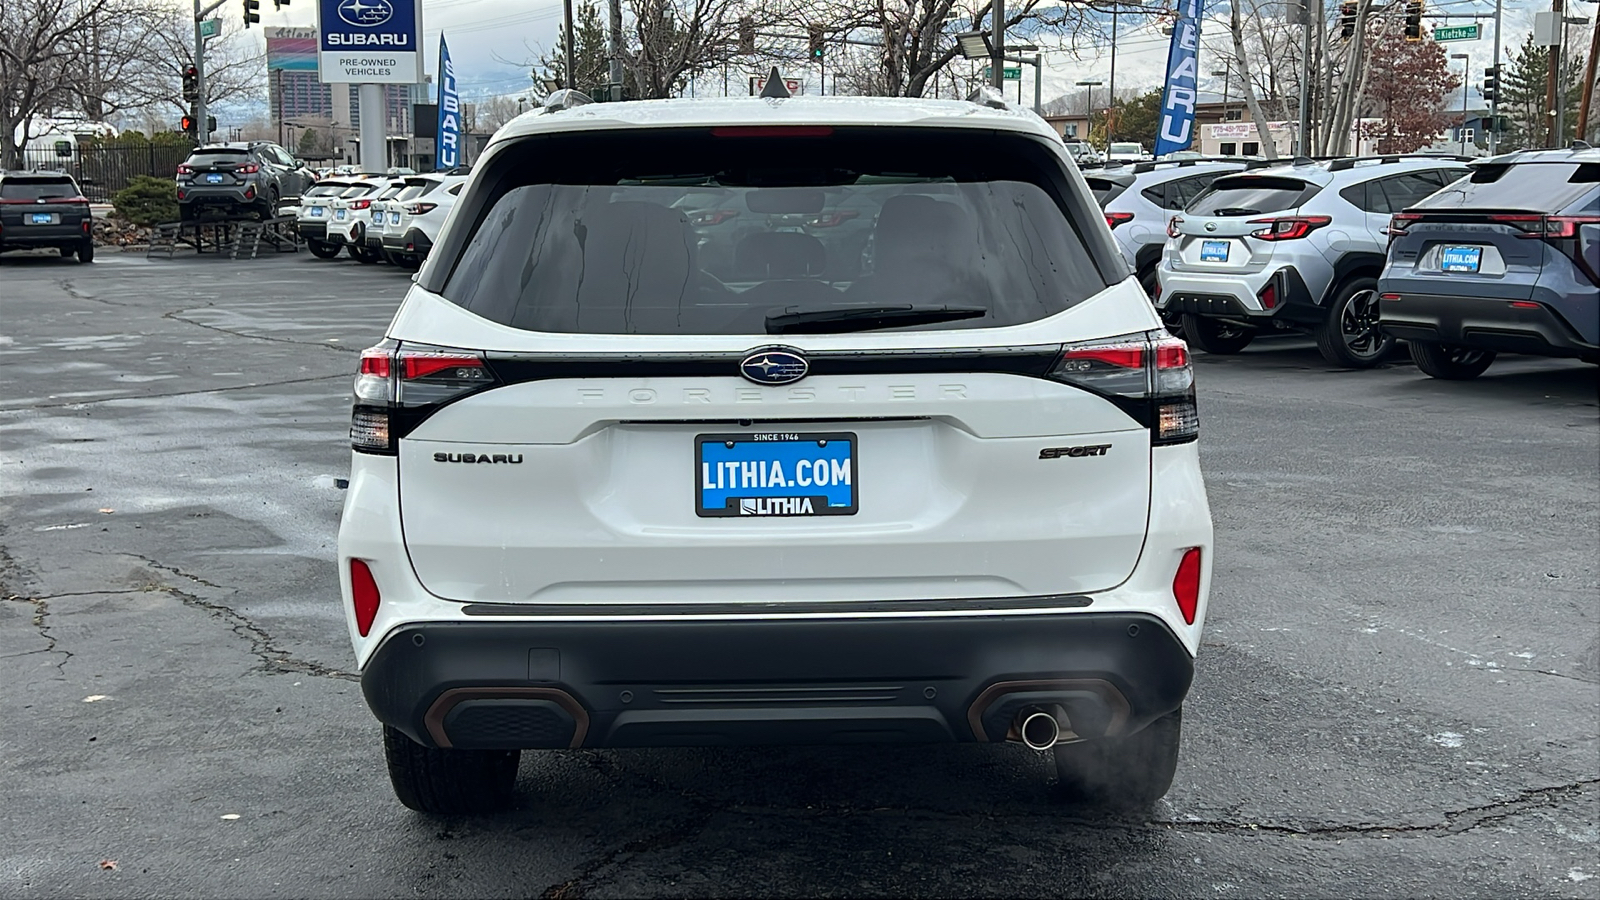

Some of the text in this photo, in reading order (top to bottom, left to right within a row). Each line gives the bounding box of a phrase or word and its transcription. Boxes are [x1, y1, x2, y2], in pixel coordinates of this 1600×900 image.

[275, 28, 317, 38] Atlant
[1441, 28, 1467, 39] Kietzke
[327, 33, 407, 46] SUBARU
[339, 58, 396, 67] PRE-OWNED
[345, 68, 391, 76] VEHICLES
[442, 59, 459, 167] SUBARU
[1443, 253, 1479, 264] LITHIA.COM
[577, 383, 968, 405] FORESTER
[753, 433, 799, 441] SINCE 1946
[1038, 443, 1112, 460] SPORT
[433, 452, 523, 464] SUBARU
[702, 458, 851, 490] LITHIA.COM
[757, 497, 814, 514] LITHIA
